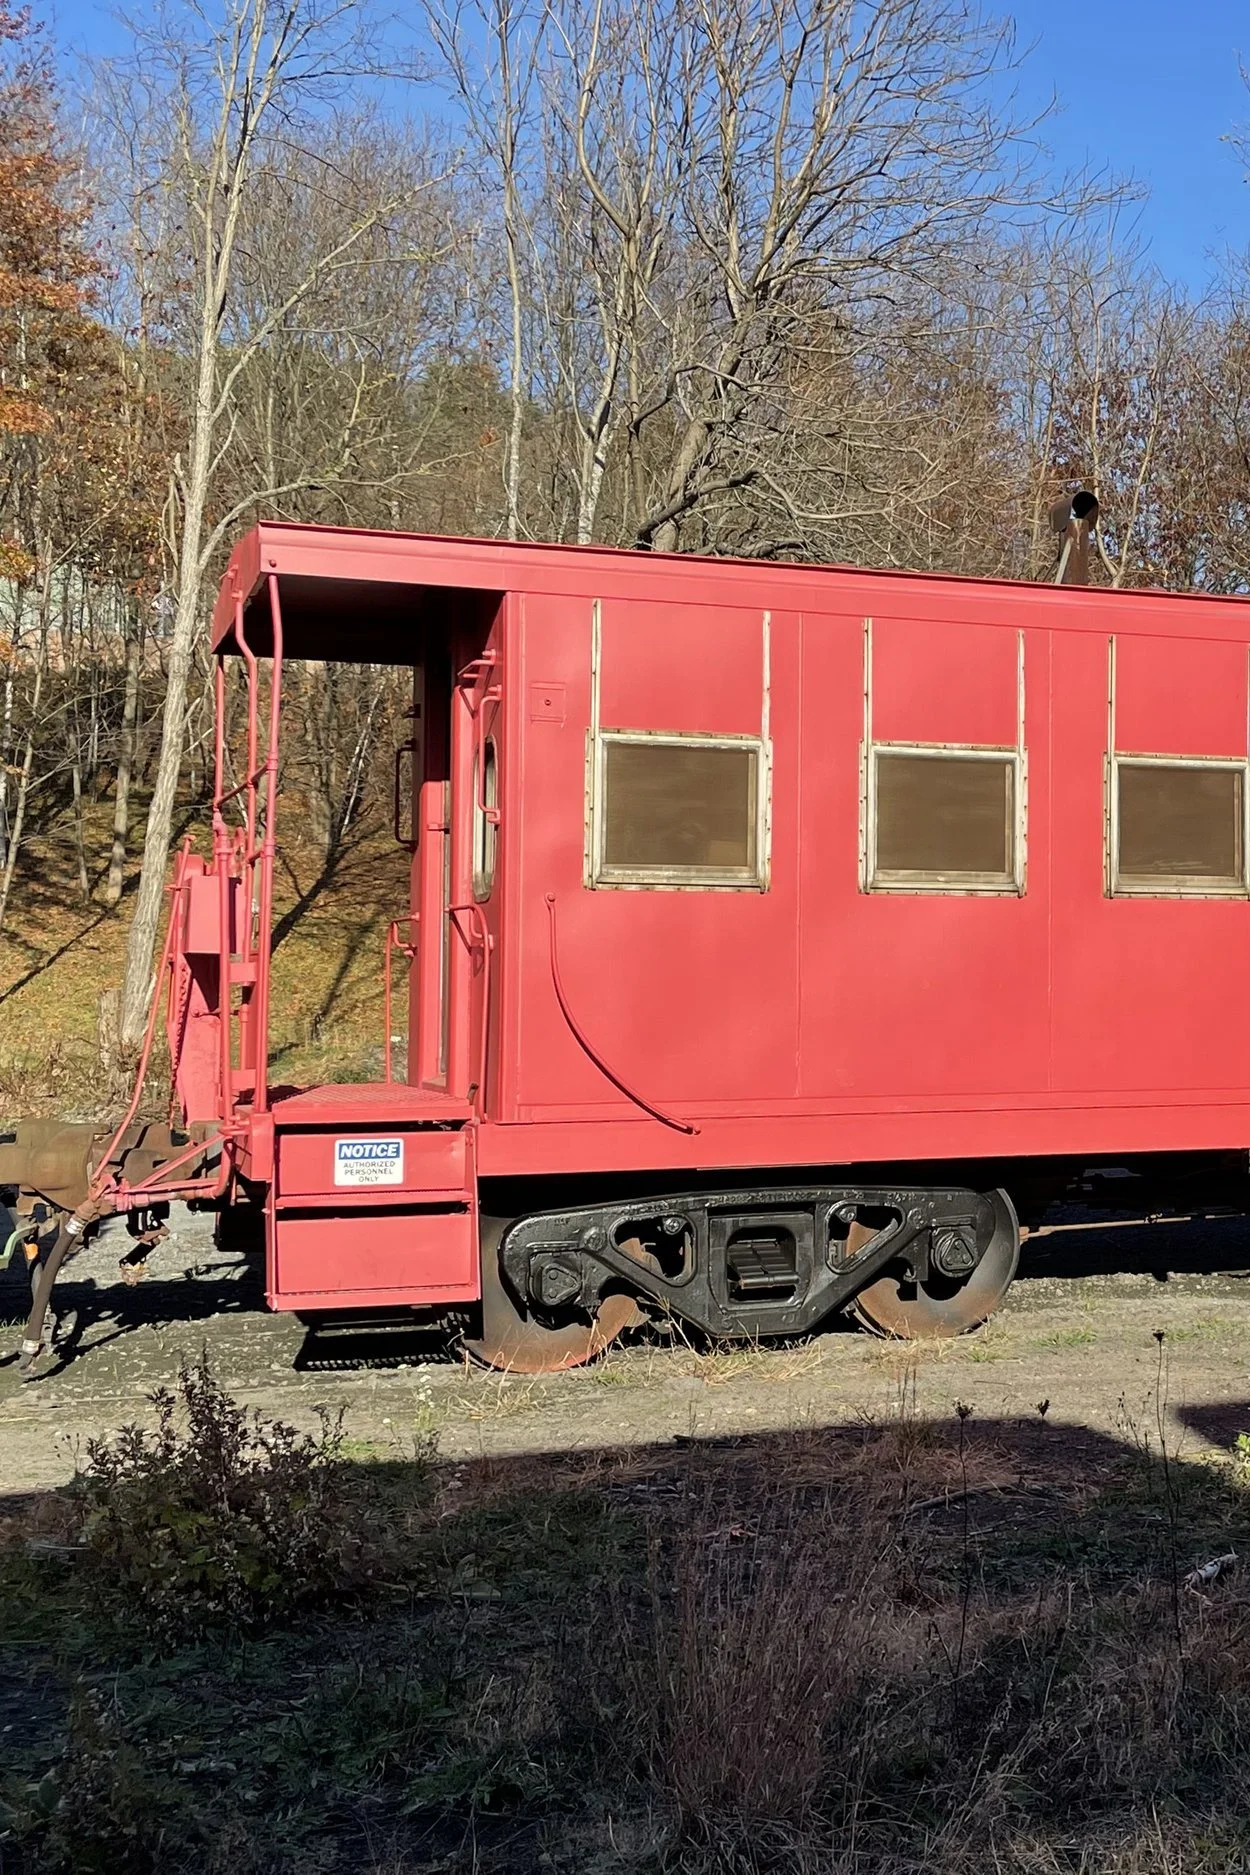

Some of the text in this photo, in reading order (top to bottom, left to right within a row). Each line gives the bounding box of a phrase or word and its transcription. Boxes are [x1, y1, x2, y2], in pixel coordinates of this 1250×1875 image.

[340, 1143, 399, 1158] NOTICE
[343, 1160, 396, 1169] AUTHORIZED
[344, 1168, 393, 1176] PERSONNEL
[358, 1175, 380, 1183] ONLY
